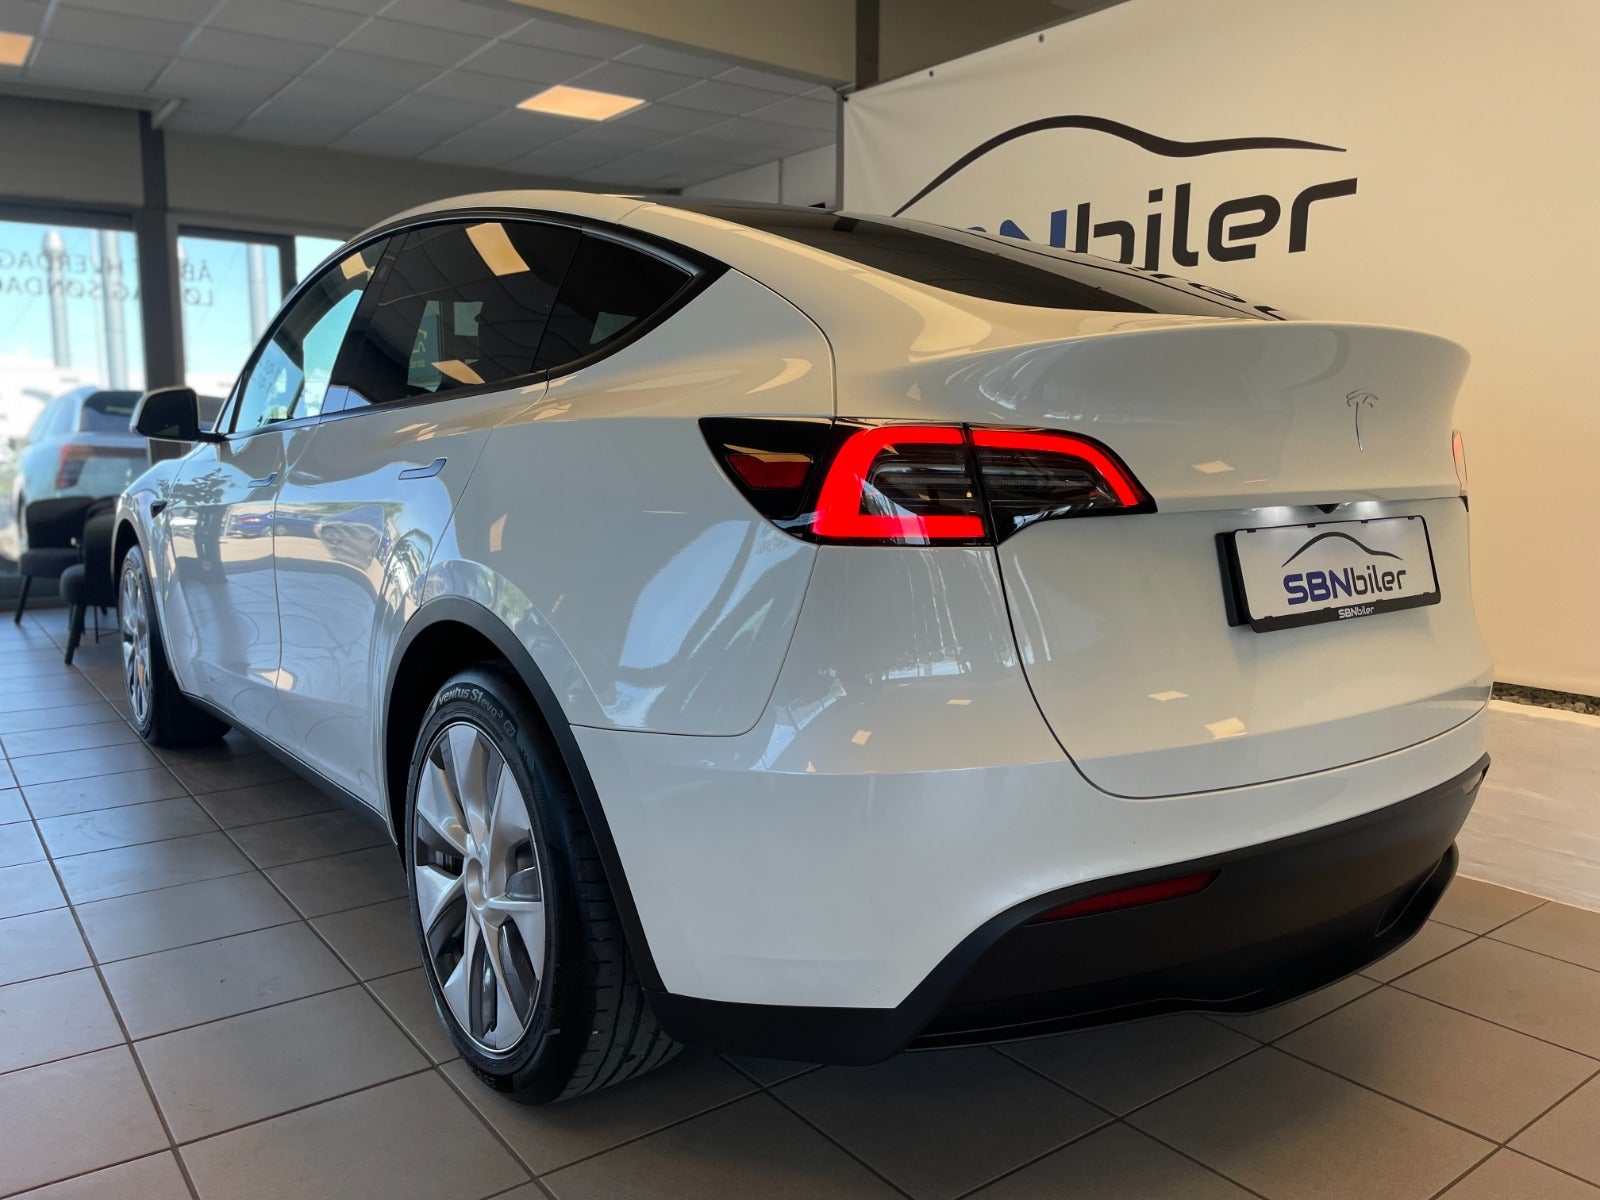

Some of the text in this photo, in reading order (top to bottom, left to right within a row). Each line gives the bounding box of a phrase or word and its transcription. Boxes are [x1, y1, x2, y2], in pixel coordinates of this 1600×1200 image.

[967, 177, 1358, 272] biler
[1283, 565, 1406, 605] SBNbiler
[1338, 605, 1375, 620] SBNbiler
